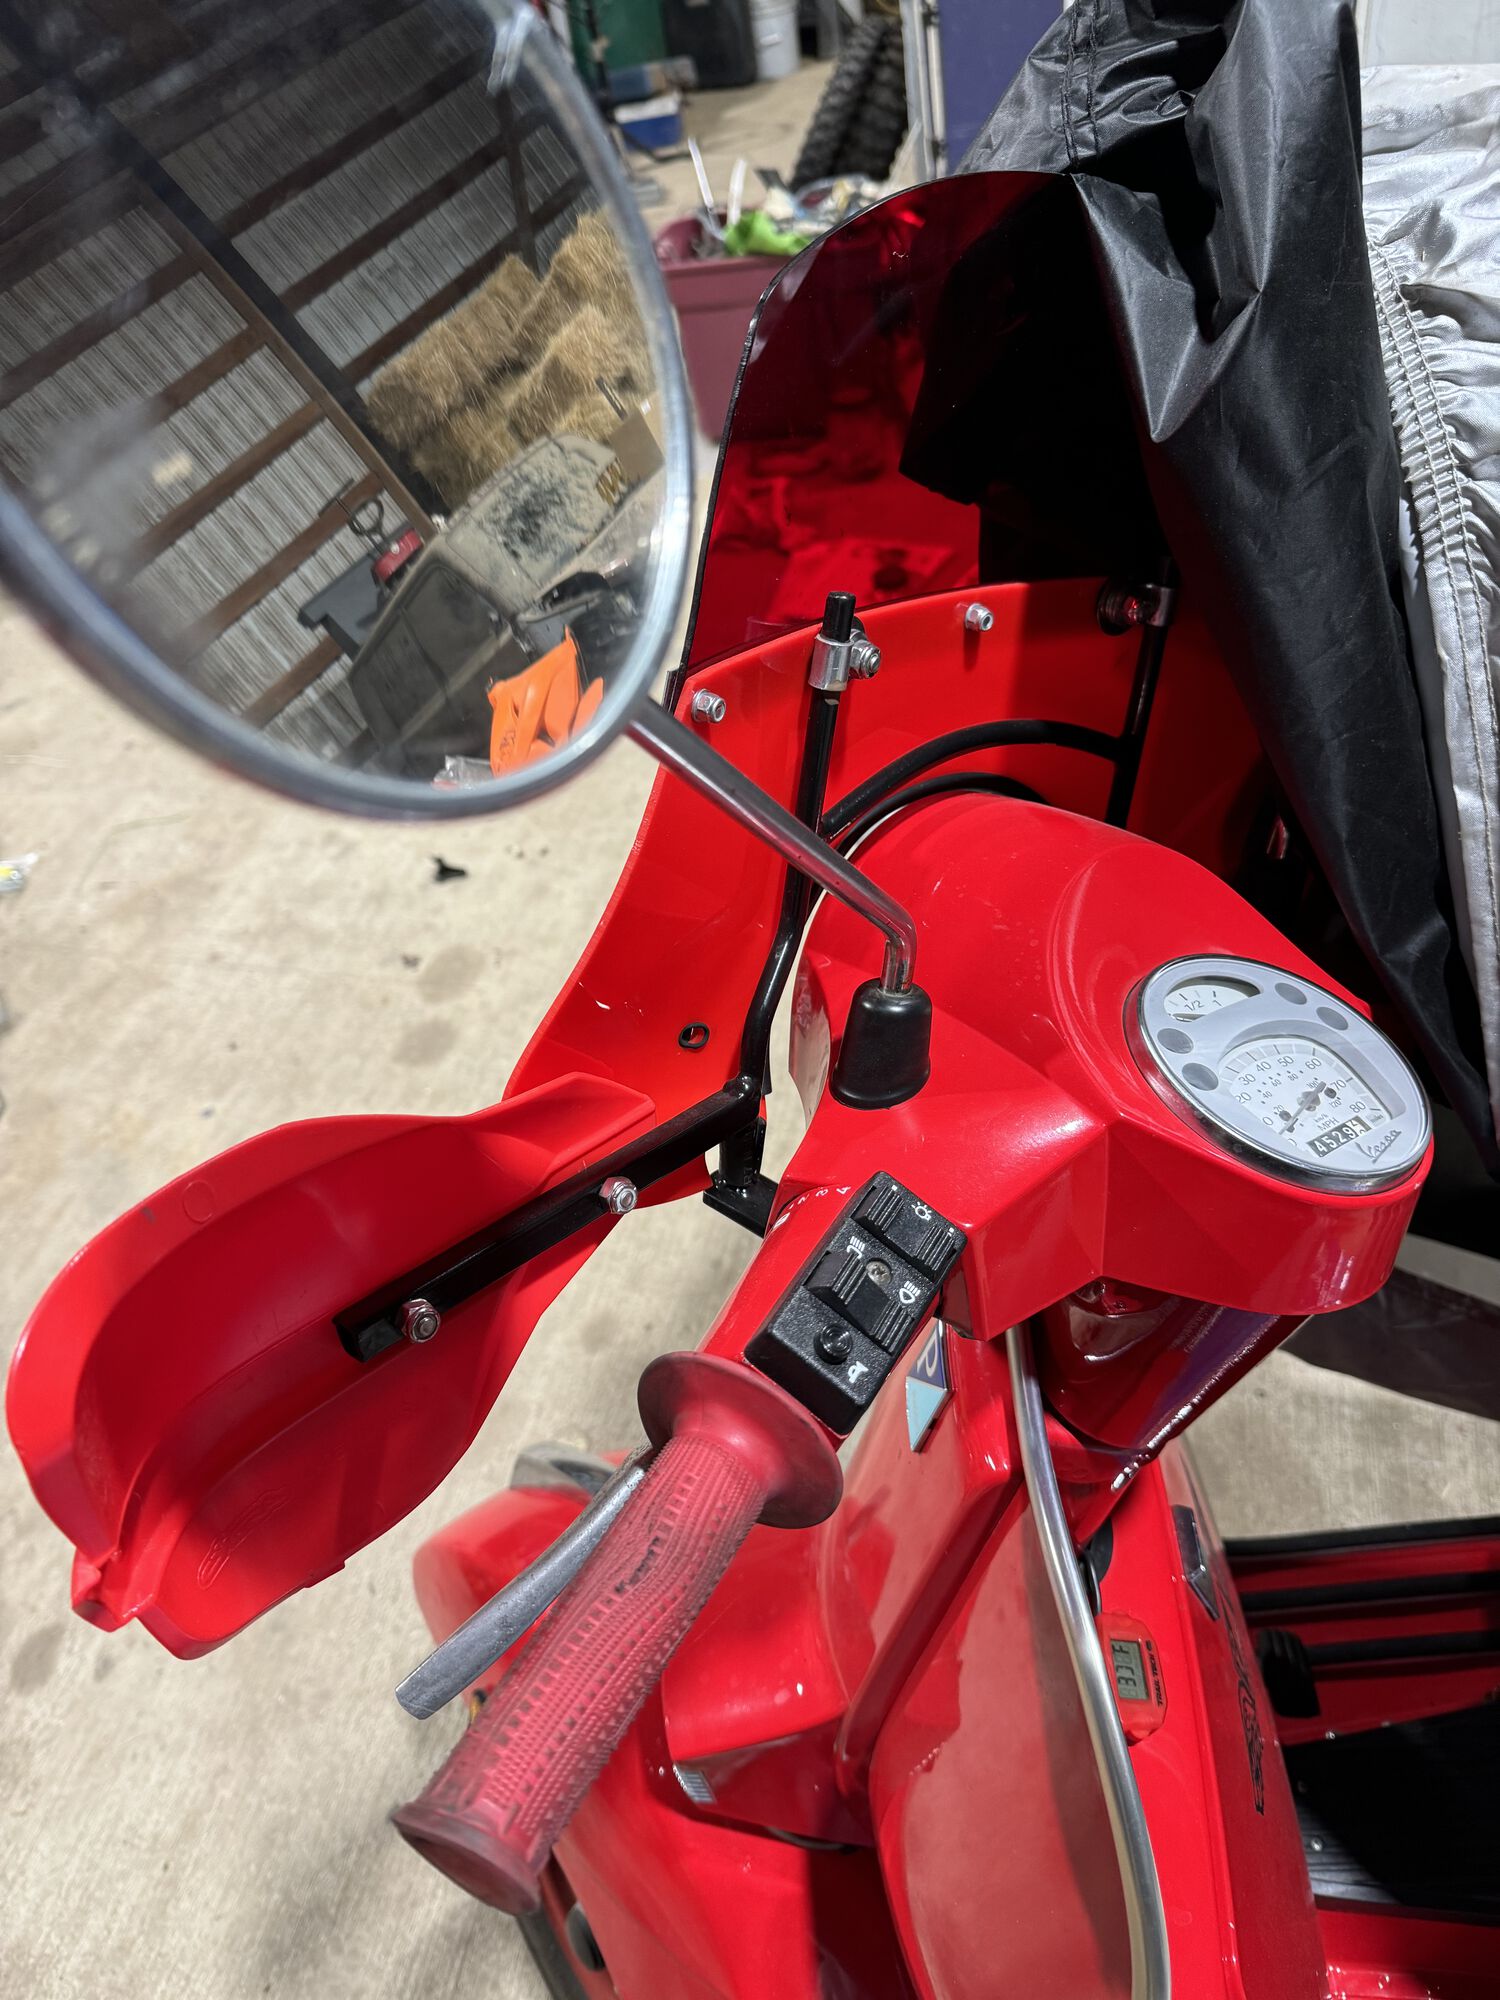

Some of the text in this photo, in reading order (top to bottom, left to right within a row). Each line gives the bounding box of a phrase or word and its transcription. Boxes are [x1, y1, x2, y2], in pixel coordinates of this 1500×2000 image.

[1184, 1000, 1204, 1011] 1/2
[1256, 1061, 1271, 1071] 40
[1277, 1056, 1294, 1067] 50
[1305, 1058, 1321, 1070] 60
[1238, 1074, 1256, 1085] 30
[1271, 1079, 1281, 1087] 60
[1330, 1080, 1346, 1091] 70
[1235, 1092, 1251, 1104] 20
[1262, 1091, 1272, 1099] 40
[1349, 1101, 1366, 1113] 80
[1263, 1117, 1273, 1126] 0
[1317, 1117, 1339, 1131] MPH
[1354, 1130, 1402, 1164] Vespa
